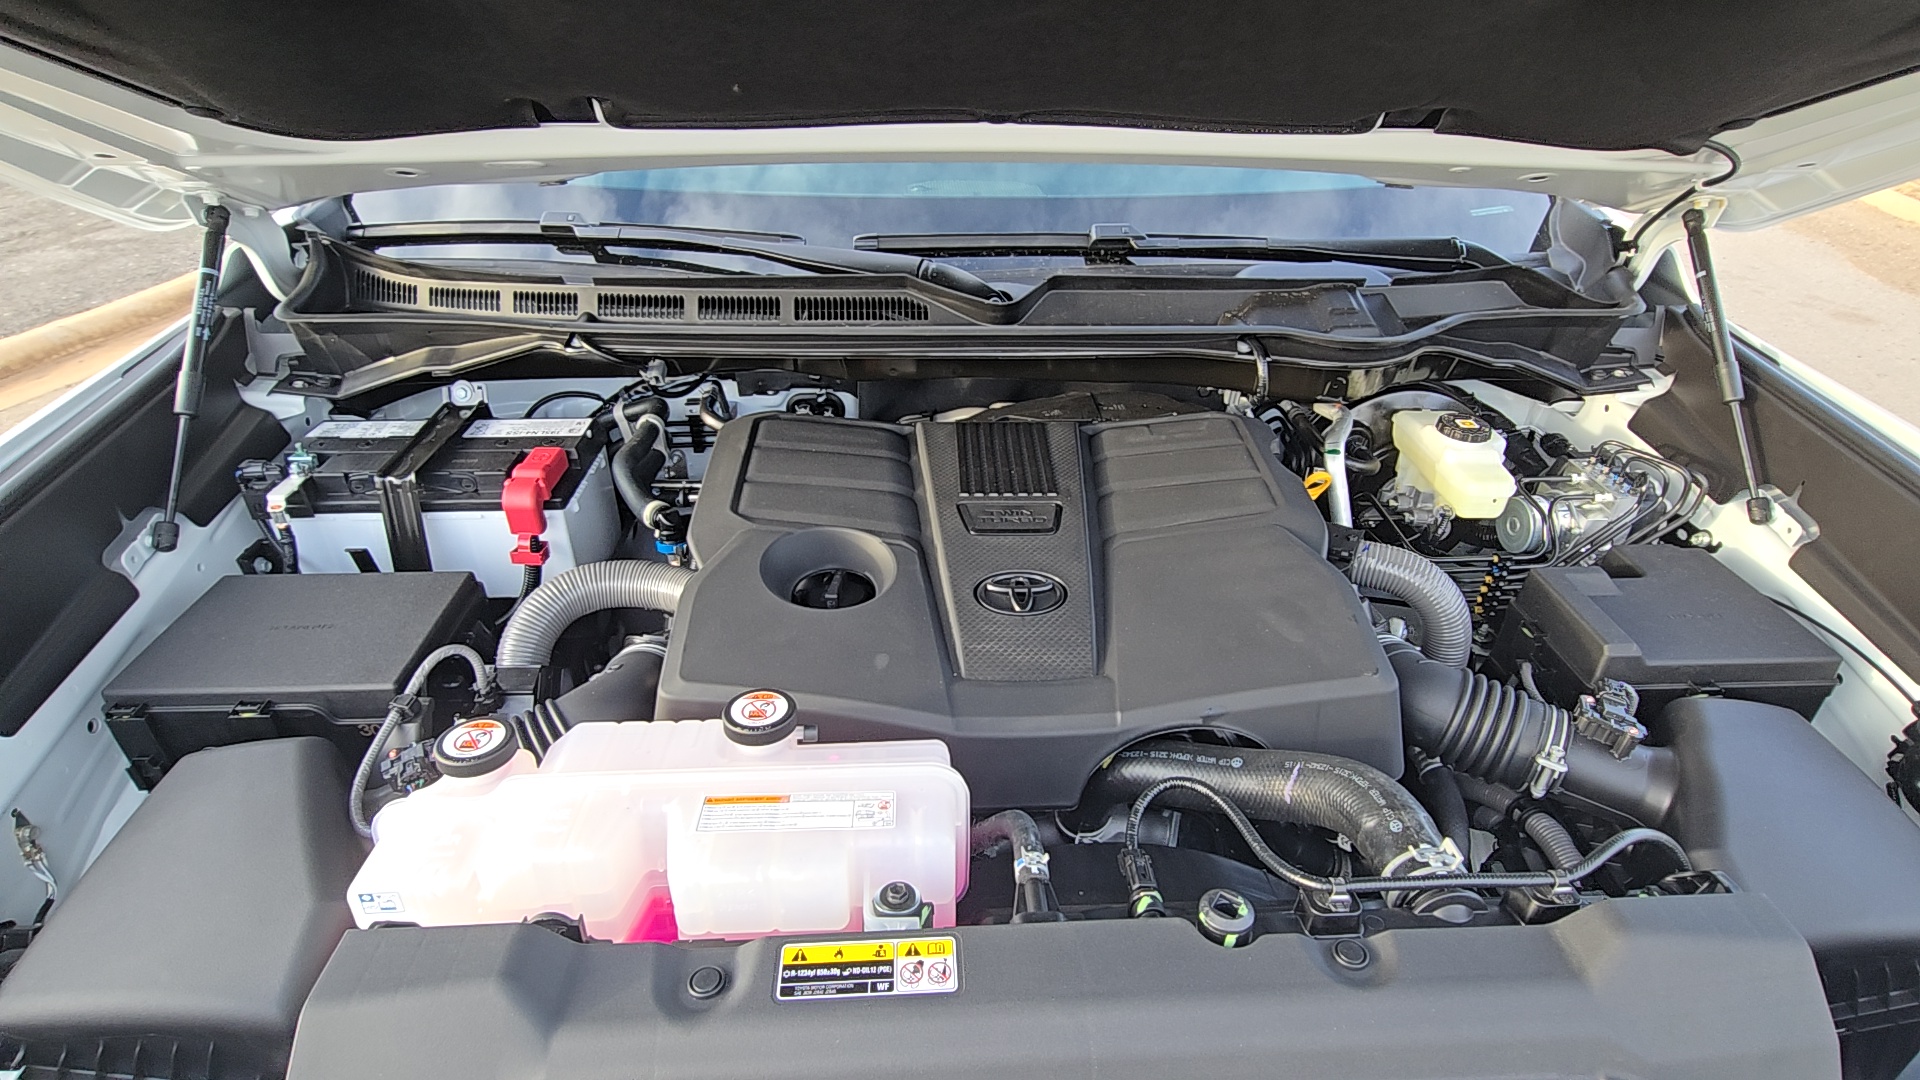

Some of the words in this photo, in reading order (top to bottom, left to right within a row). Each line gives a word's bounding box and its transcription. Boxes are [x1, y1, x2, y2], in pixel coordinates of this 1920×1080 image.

[984, 509, 1034, 517] TWIN
[977, 516, 1048, 524] TURBO
[1196, 754, 1217, 765] WATER
[1368, 788, 1387, 807] WATER
[876, 982, 890, 991] WF
